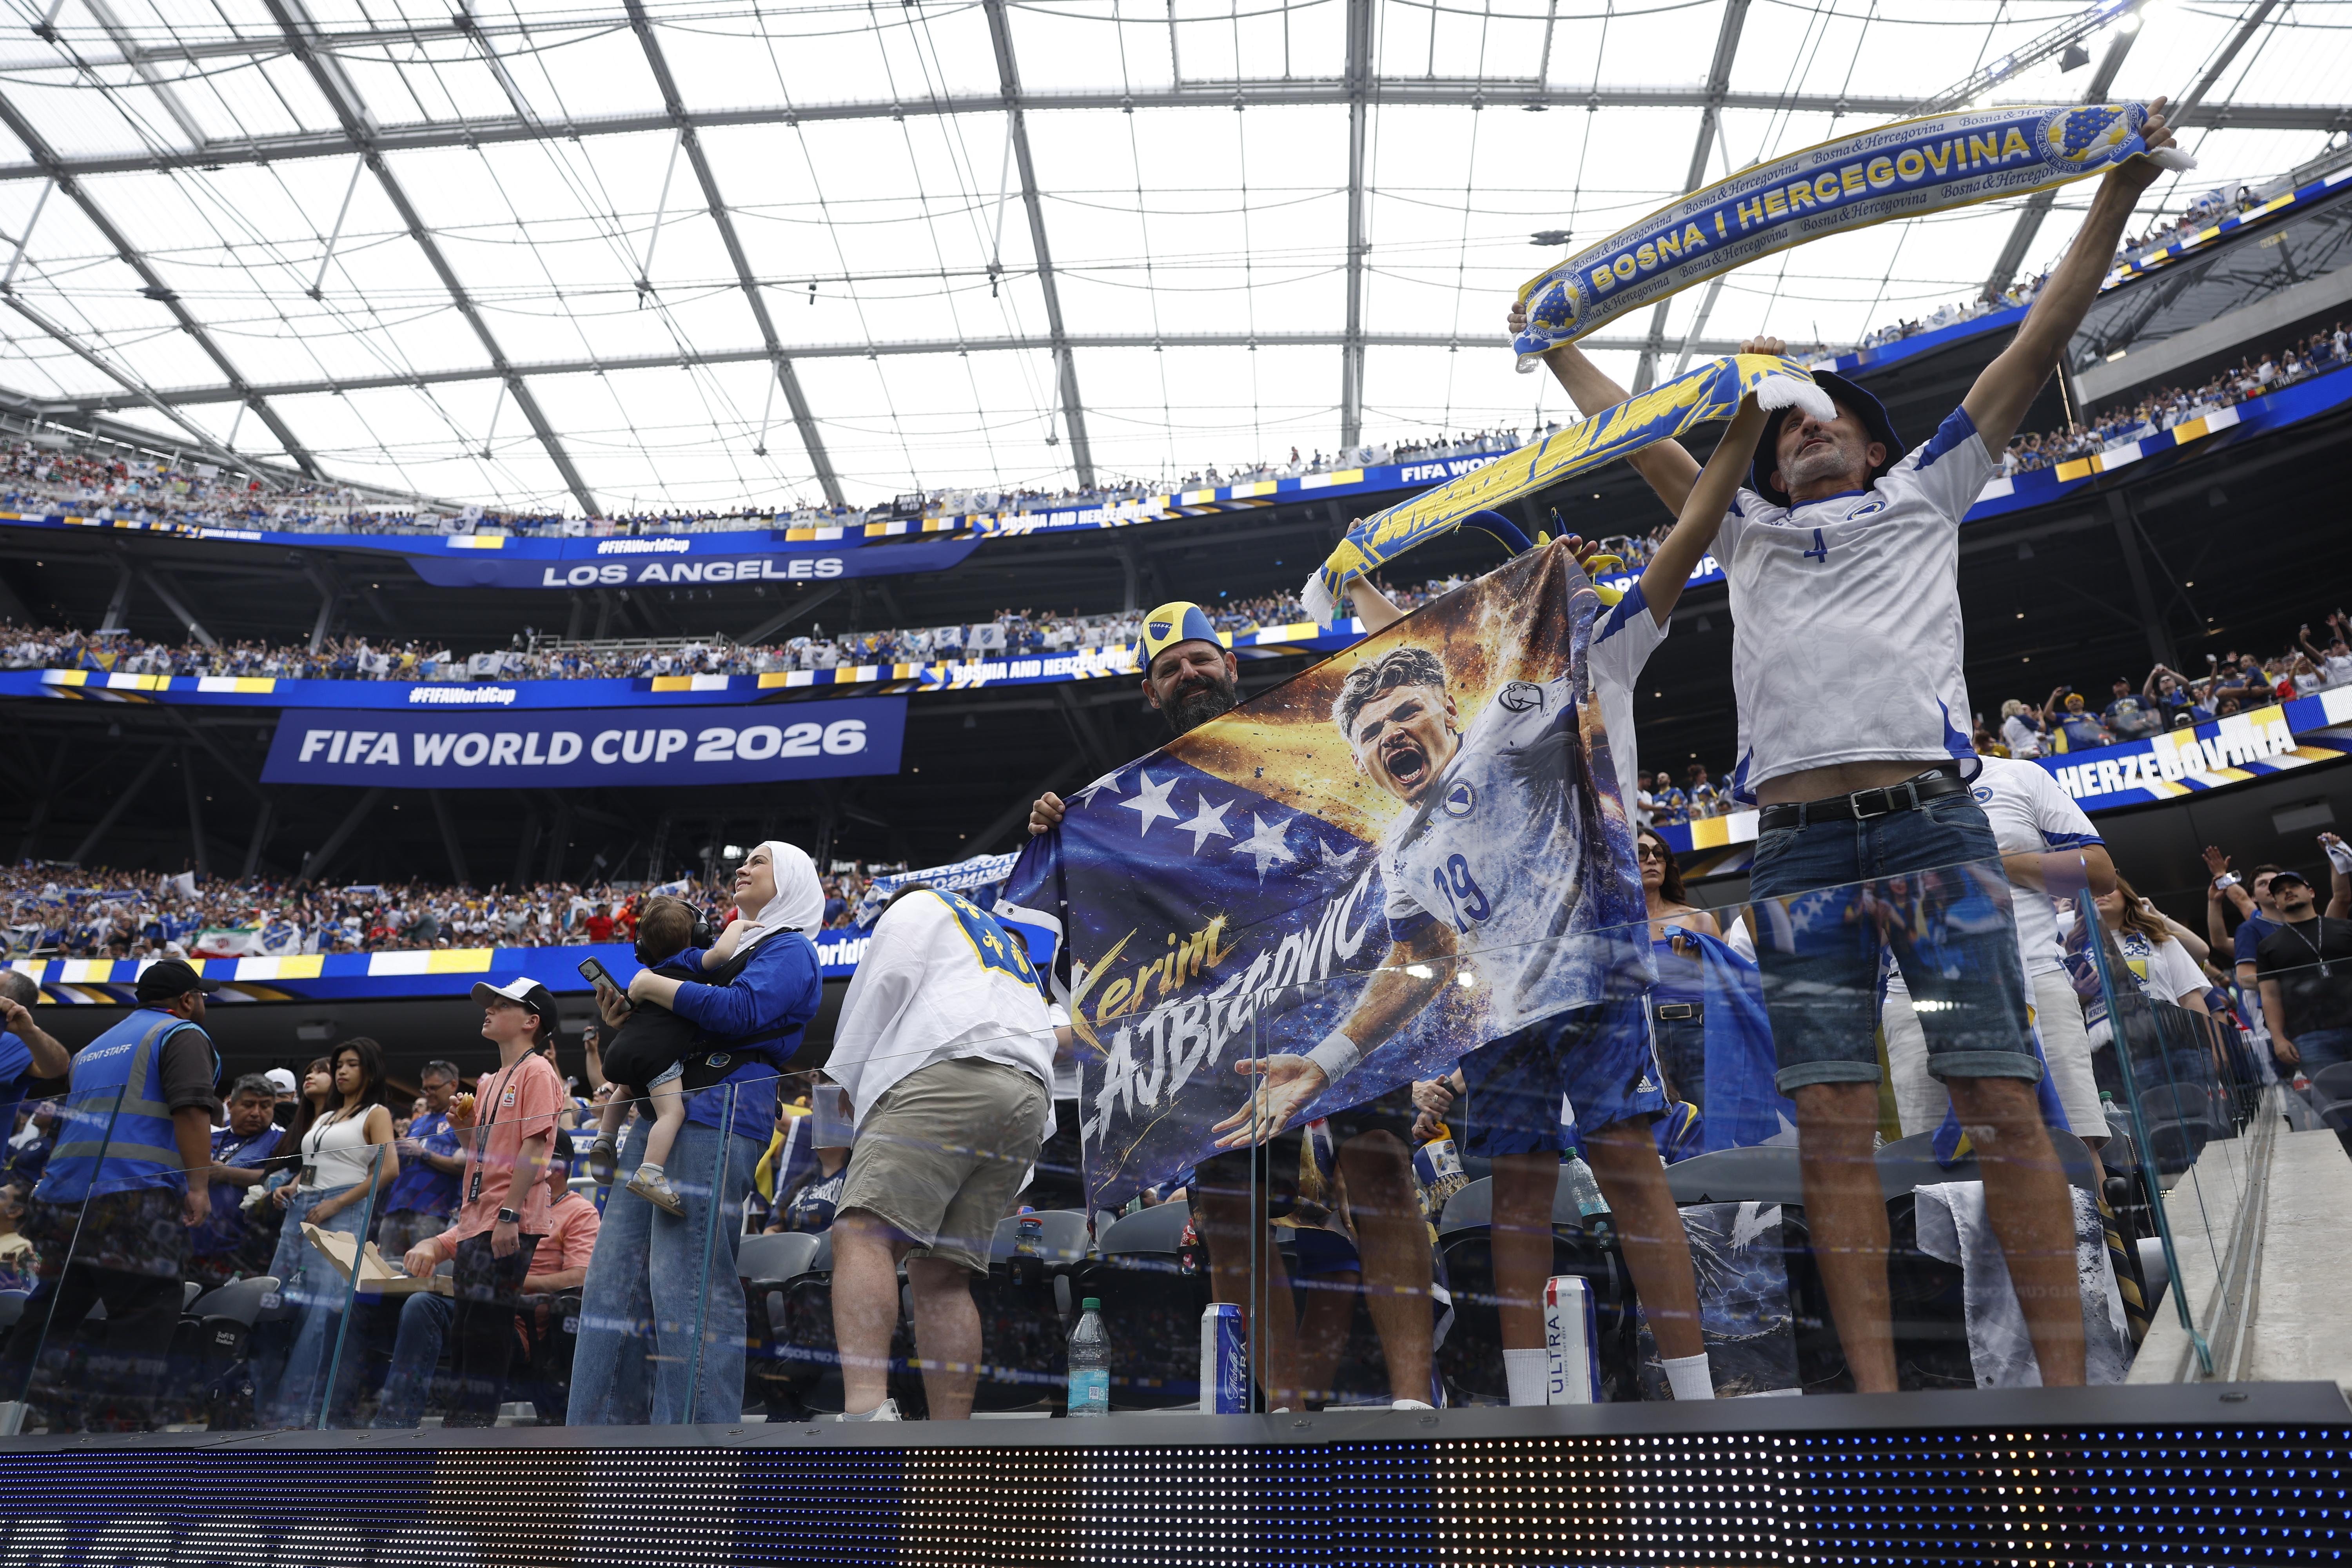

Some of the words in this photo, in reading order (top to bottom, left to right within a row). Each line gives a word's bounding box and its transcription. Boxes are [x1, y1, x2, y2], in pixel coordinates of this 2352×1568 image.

[1571, 252, 1601, 272] Bosna
[1611, 214, 1672, 251] Hercegovina
[1683, 194, 1716, 215] Bosna
[1729, 162, 1799, 195] Hercegovina
[1812, 146, 1850, 164] Bosna
[1865, 123, 1944, 150] Hercegovina
[1960, 113, 2001, 127] Bosna
[1591, 222, 1708, 294] BOSNA
[1714, 210, 1728, 239] I
[1737, 127, 2031, 230] HERCEGOVINA
[1614, 276, 1670, 309] Hercegovina
[1679, 260, 1711, 278] Bosna
[1724, 227, 1788, 262] Hercegovina
[1800, 214, 1837, 232] Bosna
[1851, 192, 1927, 216] Hercegovina
[1941, 180, 1980, 199] Bosna
[1401, 463, 1448, 483] FIFA
[1000, 513, 1047, 531] BOSNIA
[1049, 511, 1077, 527] AND
[597, 537, 690, 555] #FIFAWorldCup
[1804, 528, 1828, 563] 4
[542, 567, 629, 586] LOS
[636, 558, 844, 583] ANGELES
[953, 661, 1008, 682] BOSNIA
[1009, 660, 1042, 679] AND
[409, 686, 516, 705] #FIFAWorldCup
[298, 730, 401, 766] FIFA
[413, 731, 583, 766] WORLD
[590, 729, 688, 764] CUP
[693, 719, 867, 762] 2026
[1433, 853, 1491, 935] 19
[1071, 910, 1249, 1056] Kerim
[79, 1050, 105, 1065] EVENT
[103, 1044, 132, 1057] STAFF
[1548, 1314, 1564, 1394] ULTRA
